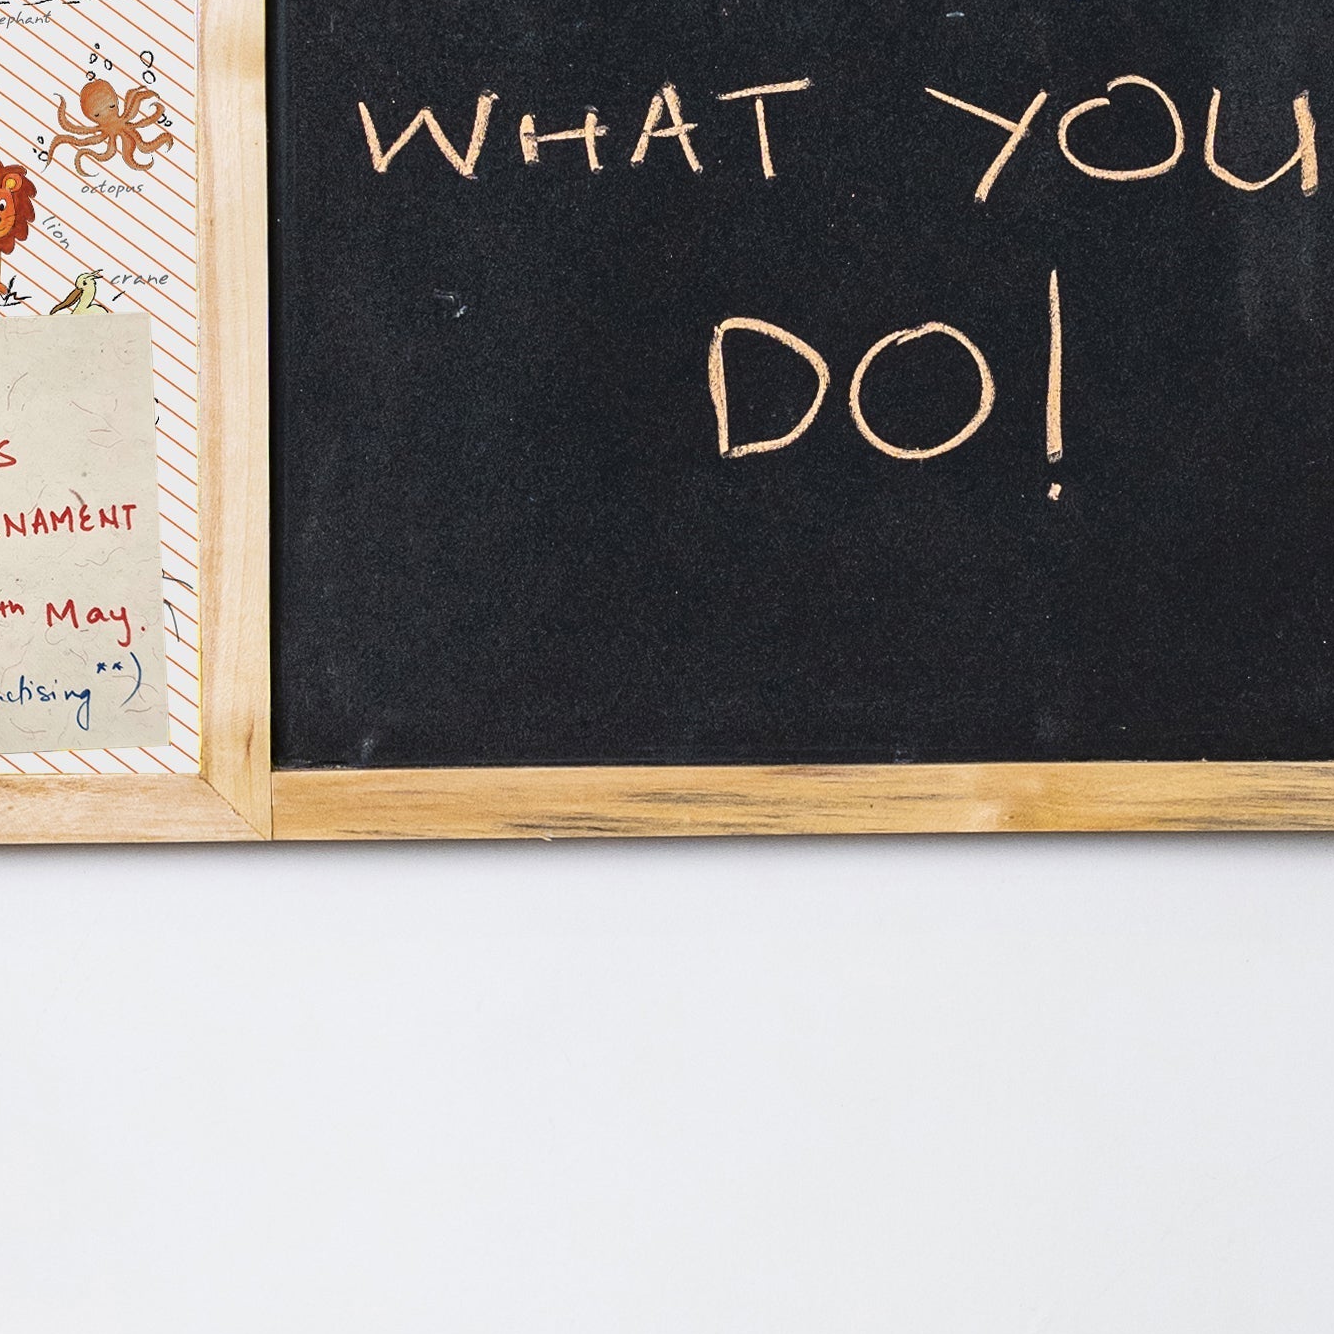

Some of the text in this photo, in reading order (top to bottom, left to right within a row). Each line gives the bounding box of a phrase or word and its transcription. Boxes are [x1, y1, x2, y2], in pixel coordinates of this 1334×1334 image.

[359, 75, 1318, 201] WHAT YOU
[81, 180, 144, 198] octopus
[41, 214, 70, 250] lion
[110, 271, 170, 286] crane
[708, 273, 1062, 500] DO!
[46, 599, 145, 647] May.
